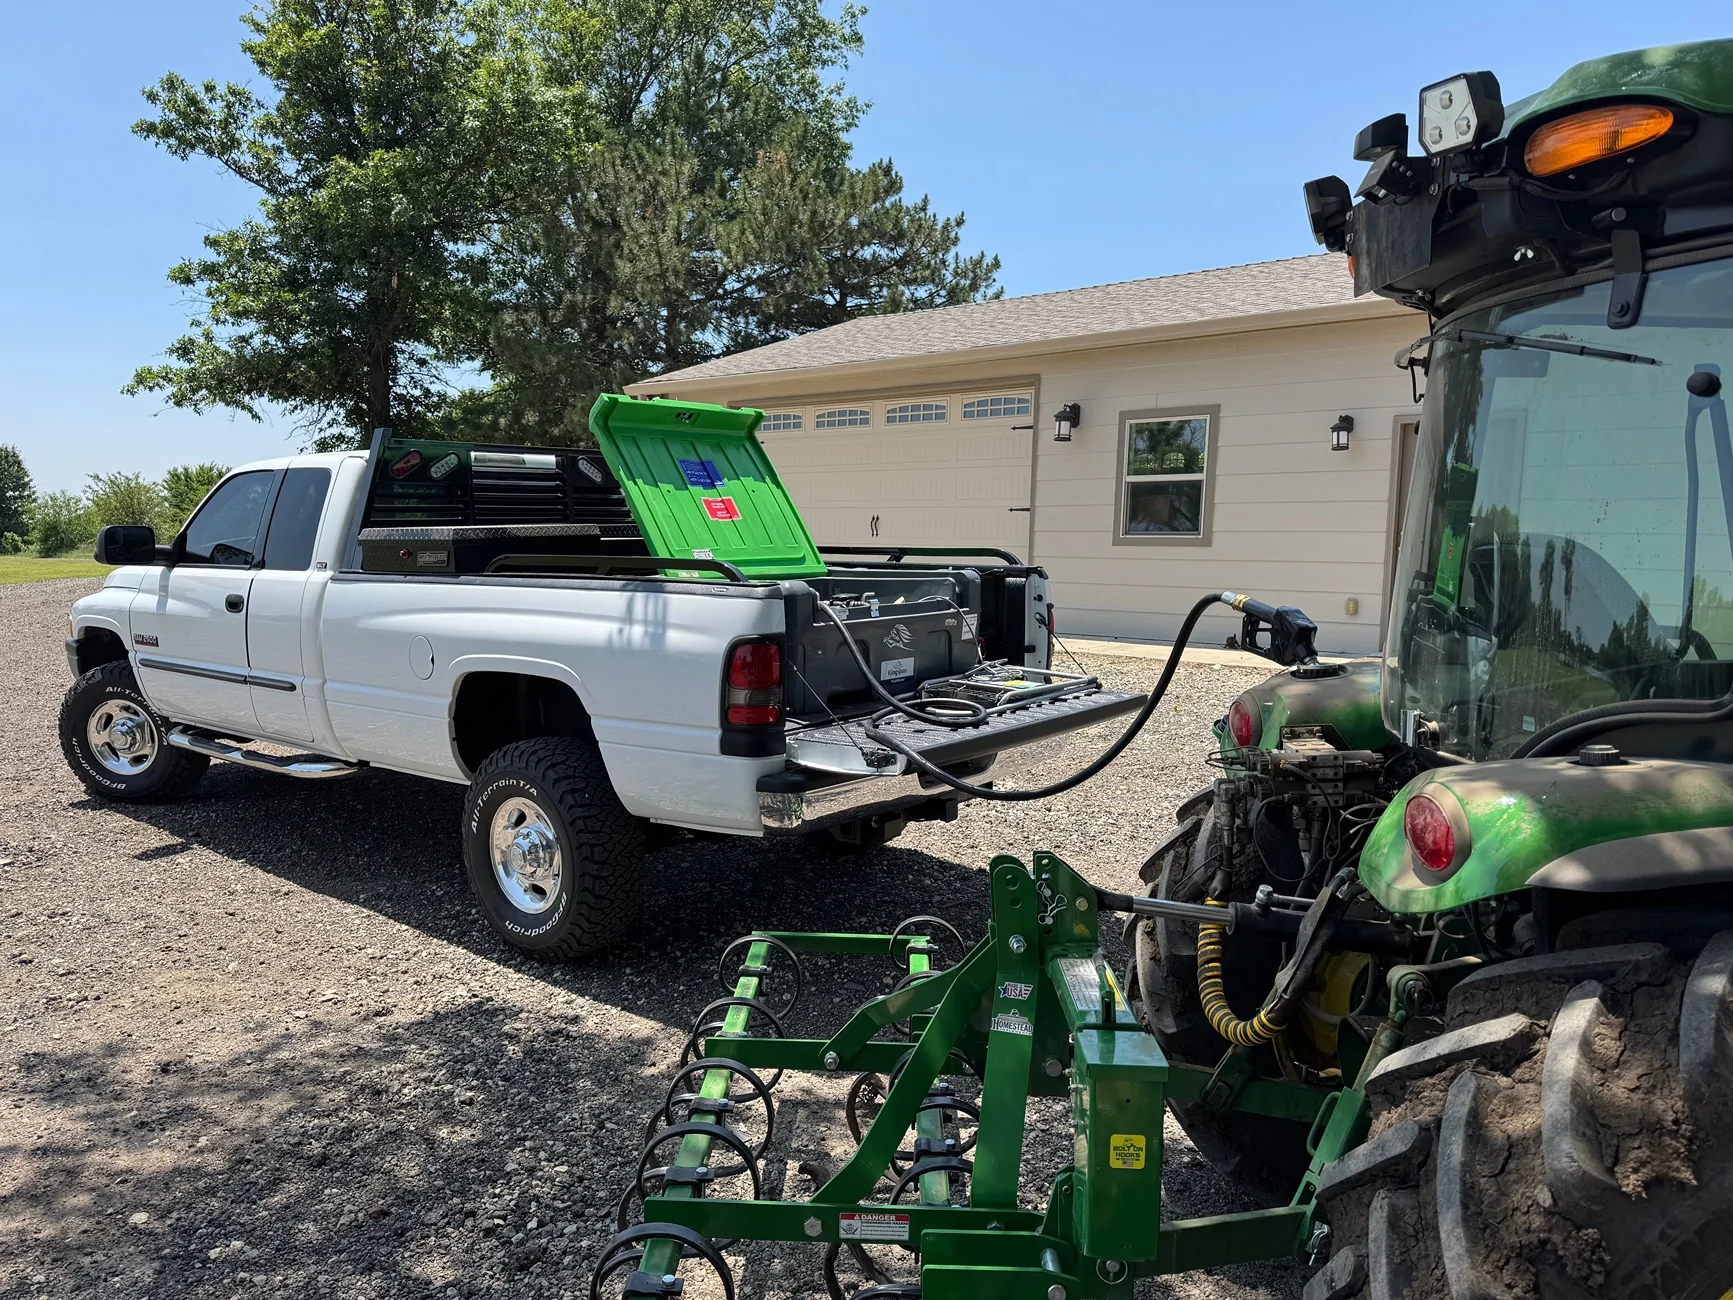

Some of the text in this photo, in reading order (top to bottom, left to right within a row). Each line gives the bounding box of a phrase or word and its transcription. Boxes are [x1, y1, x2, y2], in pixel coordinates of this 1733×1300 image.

[72, 737, 127, 790] BFGoodrich
[471, 777, 538, 834] All-Terrain T/A
[505, 891, 567, 937] BFGoodrich
[1007, 987, 1024, 998] USA
[993, 1018, 1033, 1033] HOMESTEAD
